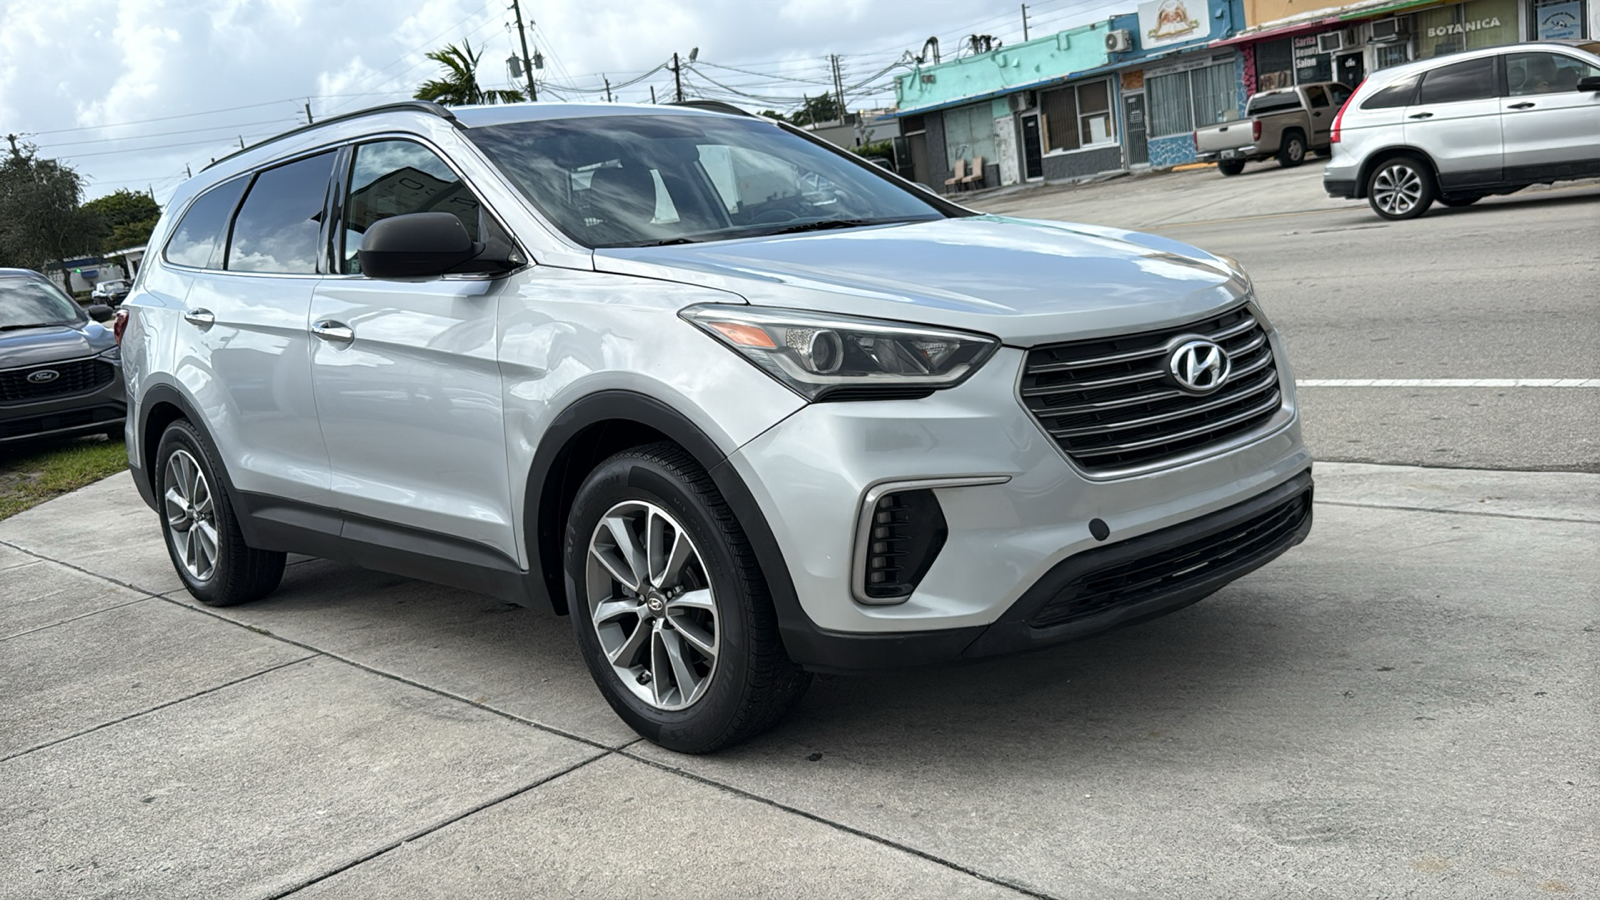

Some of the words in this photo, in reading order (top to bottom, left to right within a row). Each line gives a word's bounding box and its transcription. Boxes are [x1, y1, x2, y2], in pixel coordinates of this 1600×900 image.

[1428, 17, 1500, 37] BOTANICA
[1296, 47, 1318, 57] Beauty
[1296, 57, 1317, 69] Salon
